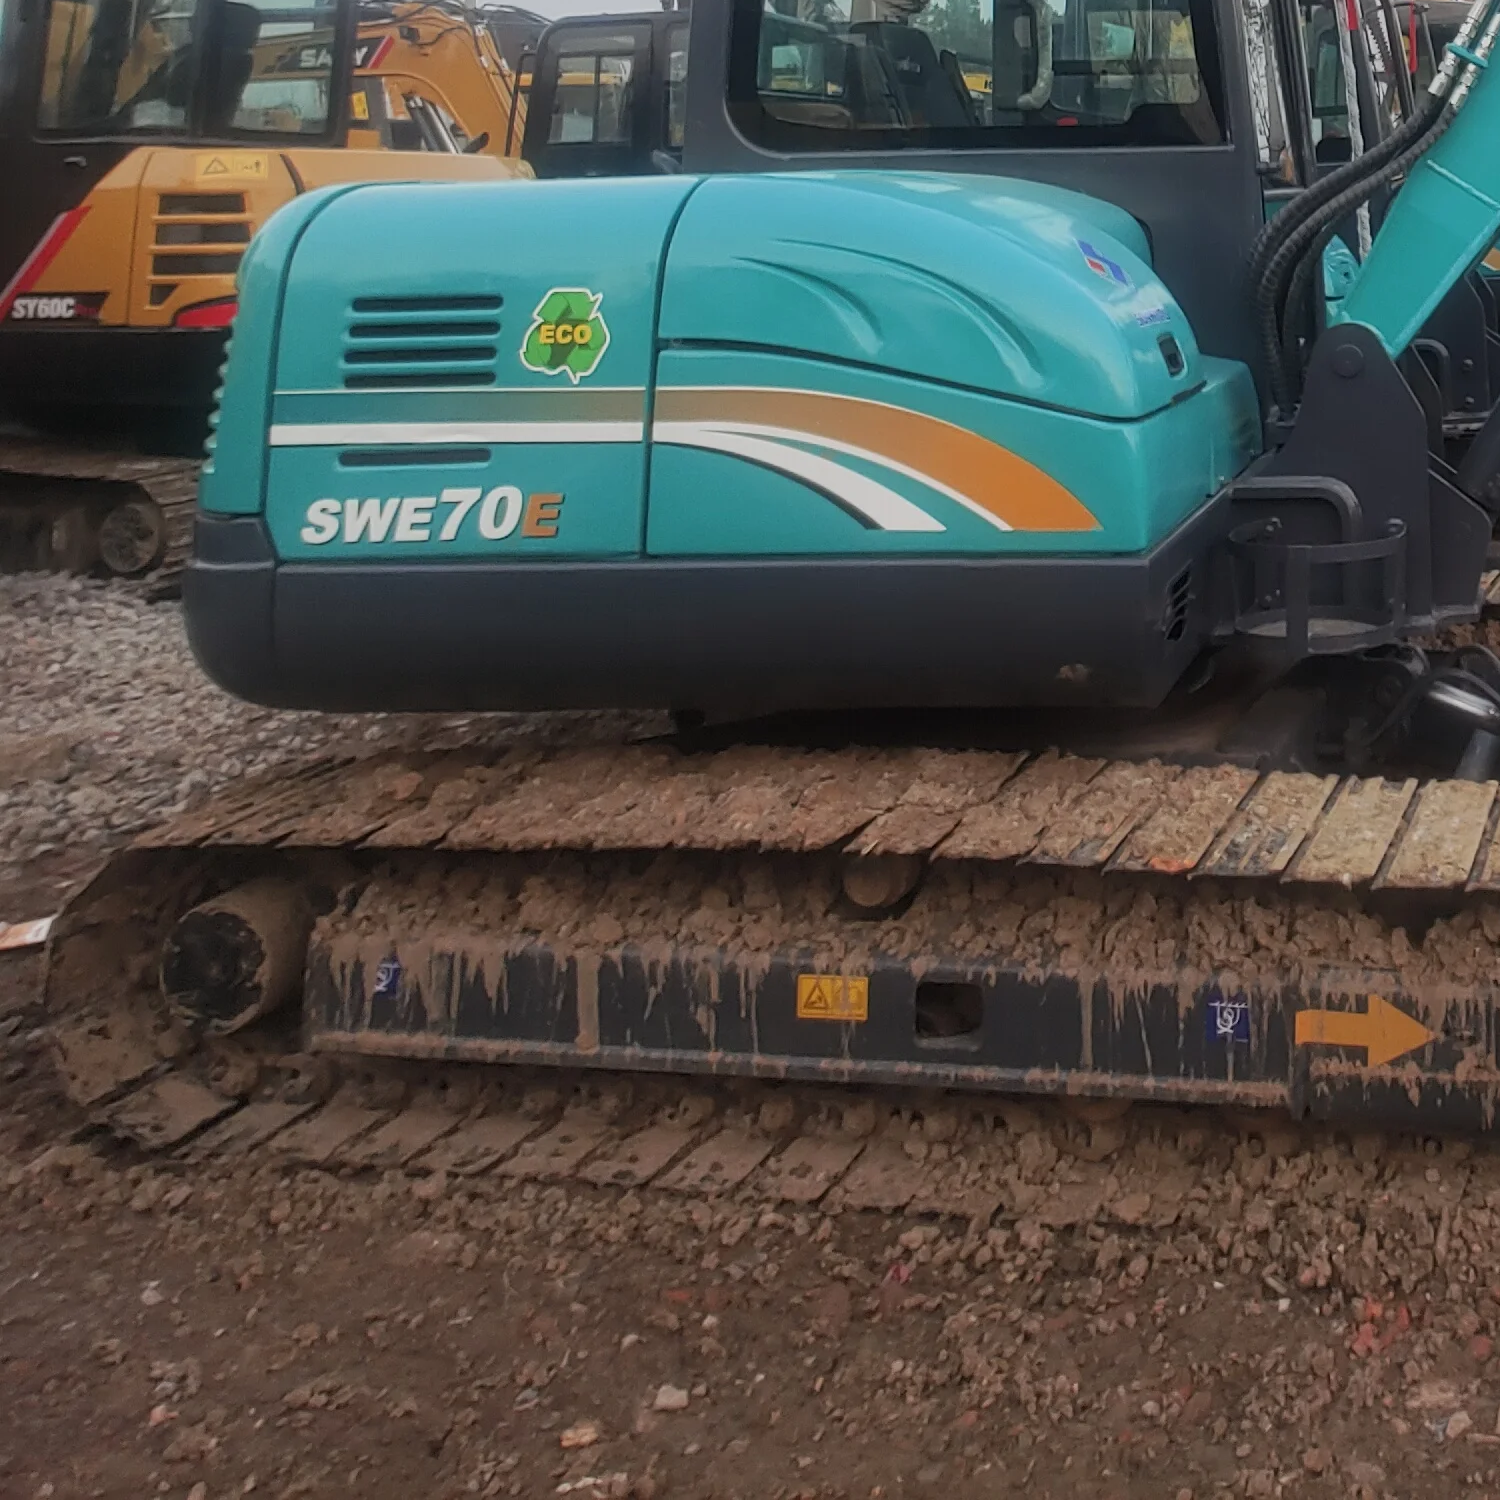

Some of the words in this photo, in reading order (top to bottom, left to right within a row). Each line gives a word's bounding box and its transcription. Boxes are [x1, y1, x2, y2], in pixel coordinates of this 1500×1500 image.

[300, 46, 369, 69] SAY
[11, 296, 75, 319] SY60C
[540, 323, 592, 345] ECO
[301, 485, 564, 545] SWE70E
